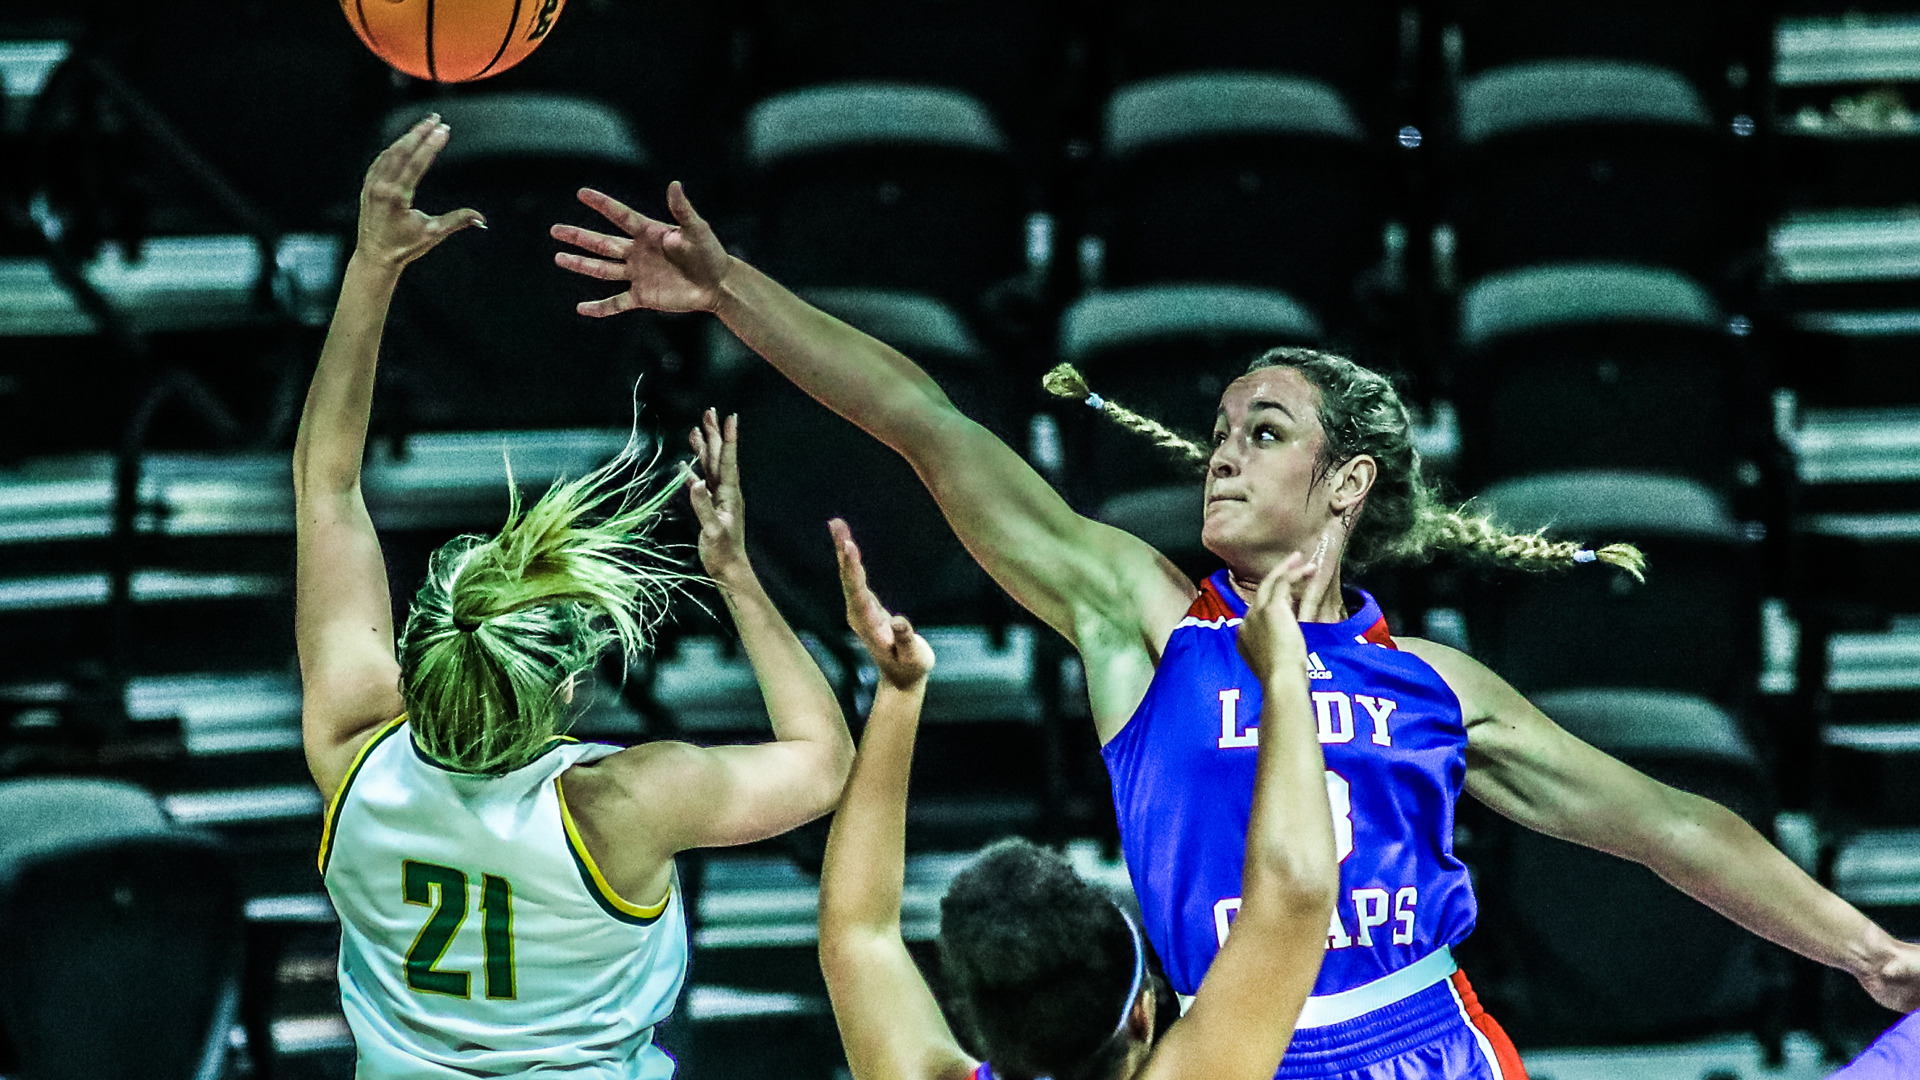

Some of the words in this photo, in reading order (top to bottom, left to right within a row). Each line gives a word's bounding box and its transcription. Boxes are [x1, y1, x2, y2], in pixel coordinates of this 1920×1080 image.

[1218, 688, 1397, 747] LDY
[402, 859, 517, 1000] 21
[1213, 886, 1418, 950] CAPS
